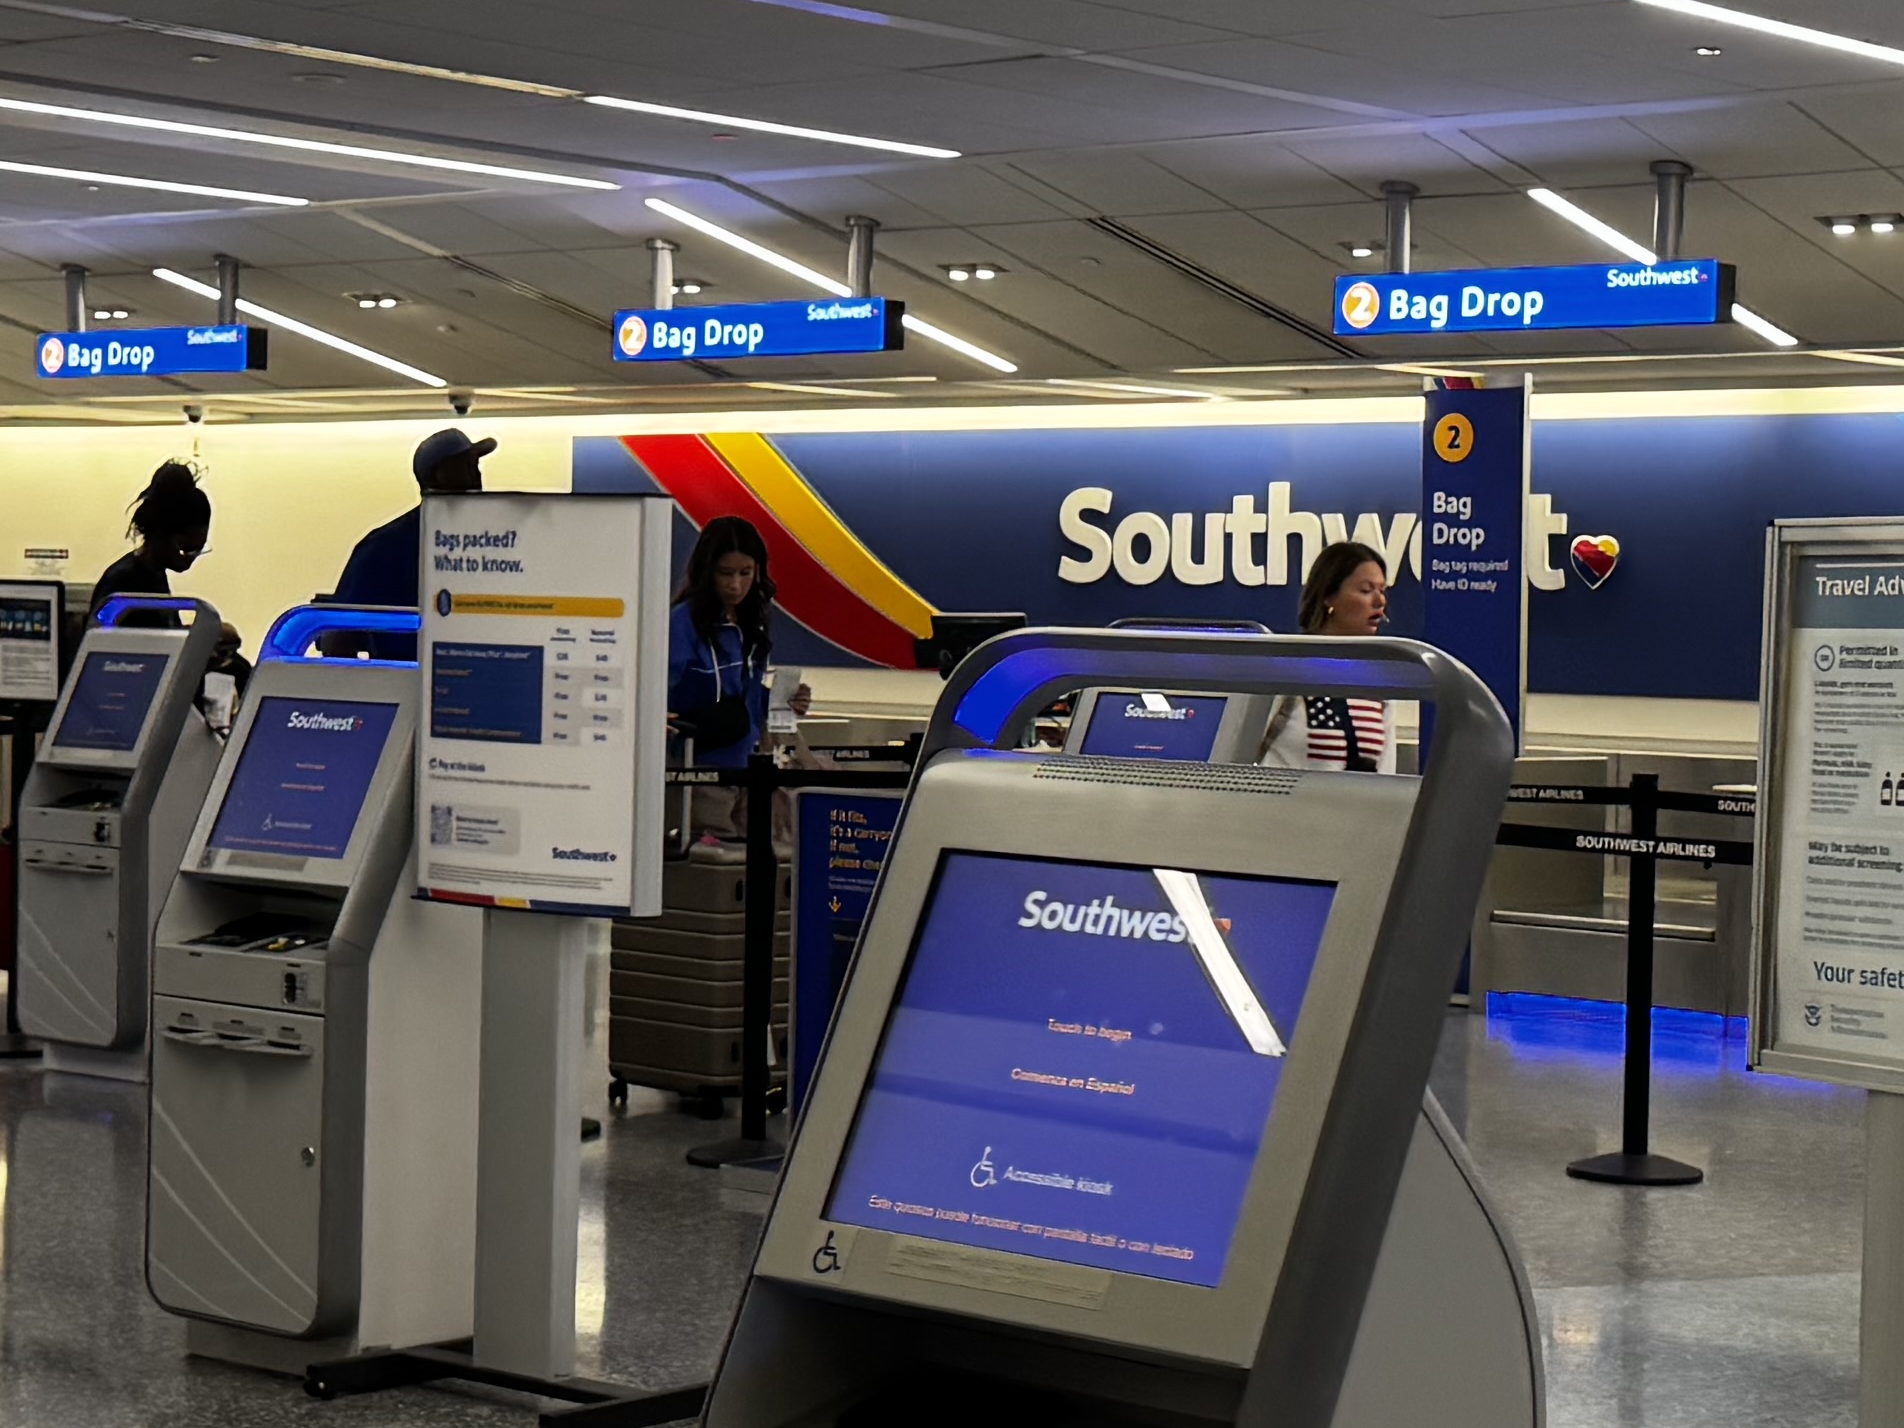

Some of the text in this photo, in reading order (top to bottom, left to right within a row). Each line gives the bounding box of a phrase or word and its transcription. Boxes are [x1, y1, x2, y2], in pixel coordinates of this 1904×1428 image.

[1348, 267, 1698, 328] 2 Bag Drop Southwest
[652, 322, 696, 356] Bag
[703, 319, 764, 352] Drop
[806, 302, 874, 321] Southwest
[67, 343, 102, 374] Bag
[107, 341, 156, 372] Drop
[1447, 425, 1462, 450] 2
[1433, 491, 1473, 521] Bag
[434, 529, 517, 552] Bags packed?
[1057, 480, 1569, 591] Southwt
[1431, 522, 1486, 552] Drop
[434, 555, 524, 574] What to know.
[1815, 575, 1870, 597] Travel
[286, 711, 355, 731] Southwest
[1538, 788, 1585, 801] AIRLINES
[552, 846, 609, 863] Southwest
[1575, 834, 1716, 859] SOUTHWEST AIRLINES
[1017, 889, 1196, 944] Southwes
[1813, 960, 1856, 985] Your
[1002, 1166, 1075, 1190] Accessible
